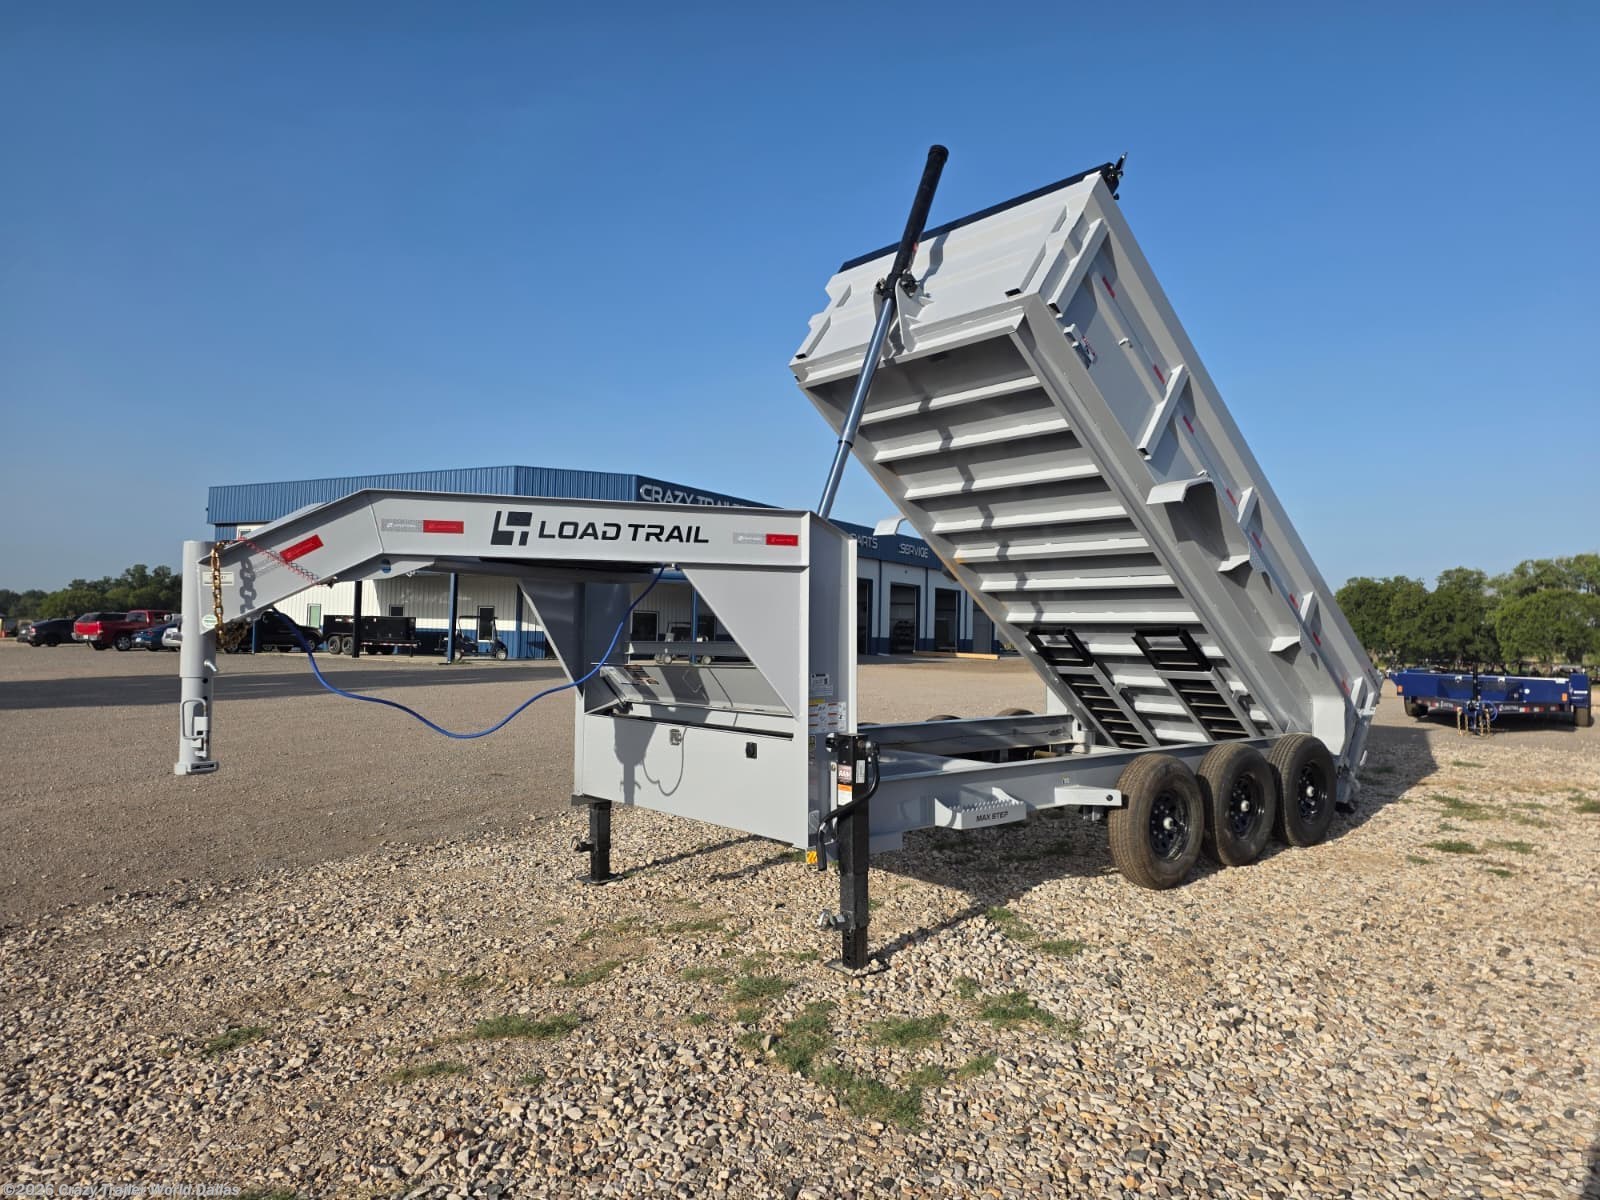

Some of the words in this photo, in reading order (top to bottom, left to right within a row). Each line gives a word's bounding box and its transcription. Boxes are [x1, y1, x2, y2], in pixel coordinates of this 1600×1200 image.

[639, 484, 694, 504] CRAZY
[538, 520, 622, 541] LOAD
[628, 523, 710, 543] TRAIL
[899, 543, 929, 559] SERVICE
[976, 813, 991, 822] MAX
[992, 811, 1009, 820] STEP
